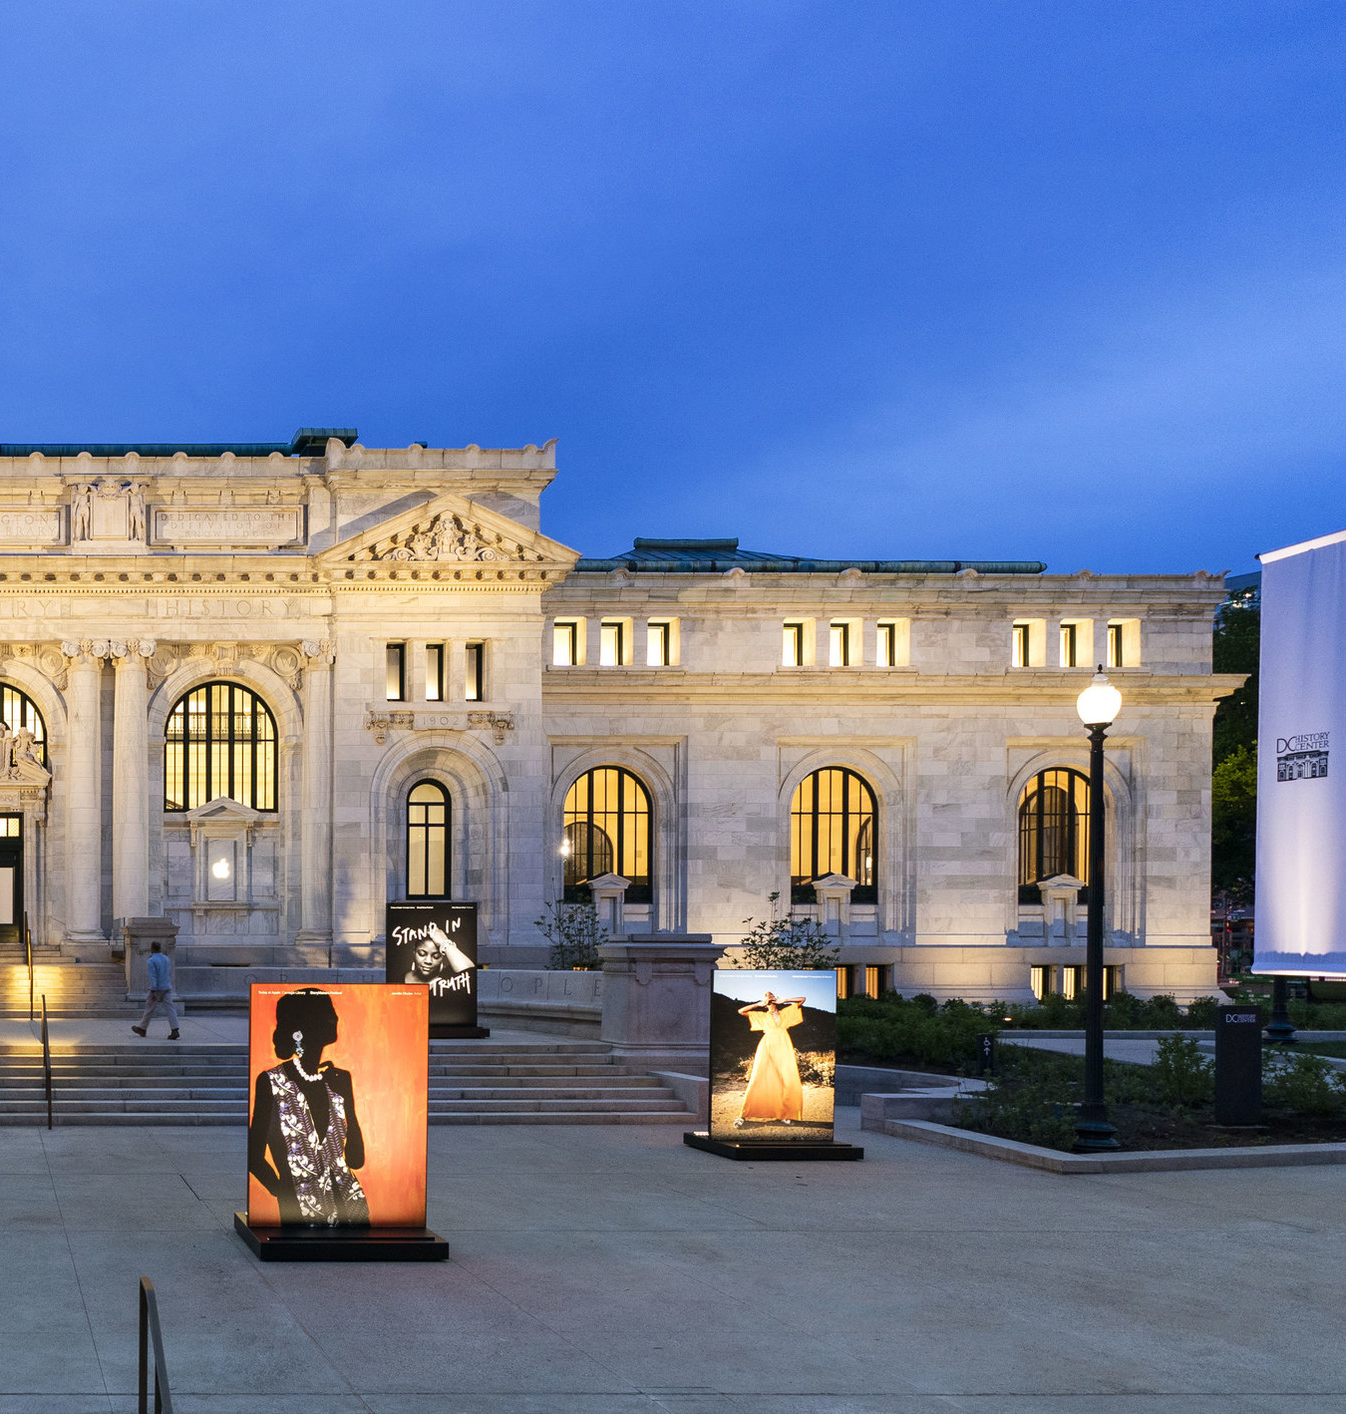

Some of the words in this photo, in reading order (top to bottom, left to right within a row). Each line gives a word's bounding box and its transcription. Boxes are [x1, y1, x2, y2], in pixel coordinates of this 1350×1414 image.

[160, 513, 238, 522] DEDICATED
[247, 513, 261, 522] TO
[270, 513, 293, 522] THE
[166, 599, 295, 616] HISTORY
[423, 716, 459, 726] 1902
[1276, 736, 1296, 754] DC
[1295, 731, 1330, 744] HISTORY
[1295, 740, 1330, 751] CENTER
[391, 921, 437, 947] STAND
[445, 916, 461, 934] IN
[429, 971, 471, 997] TRUTH
